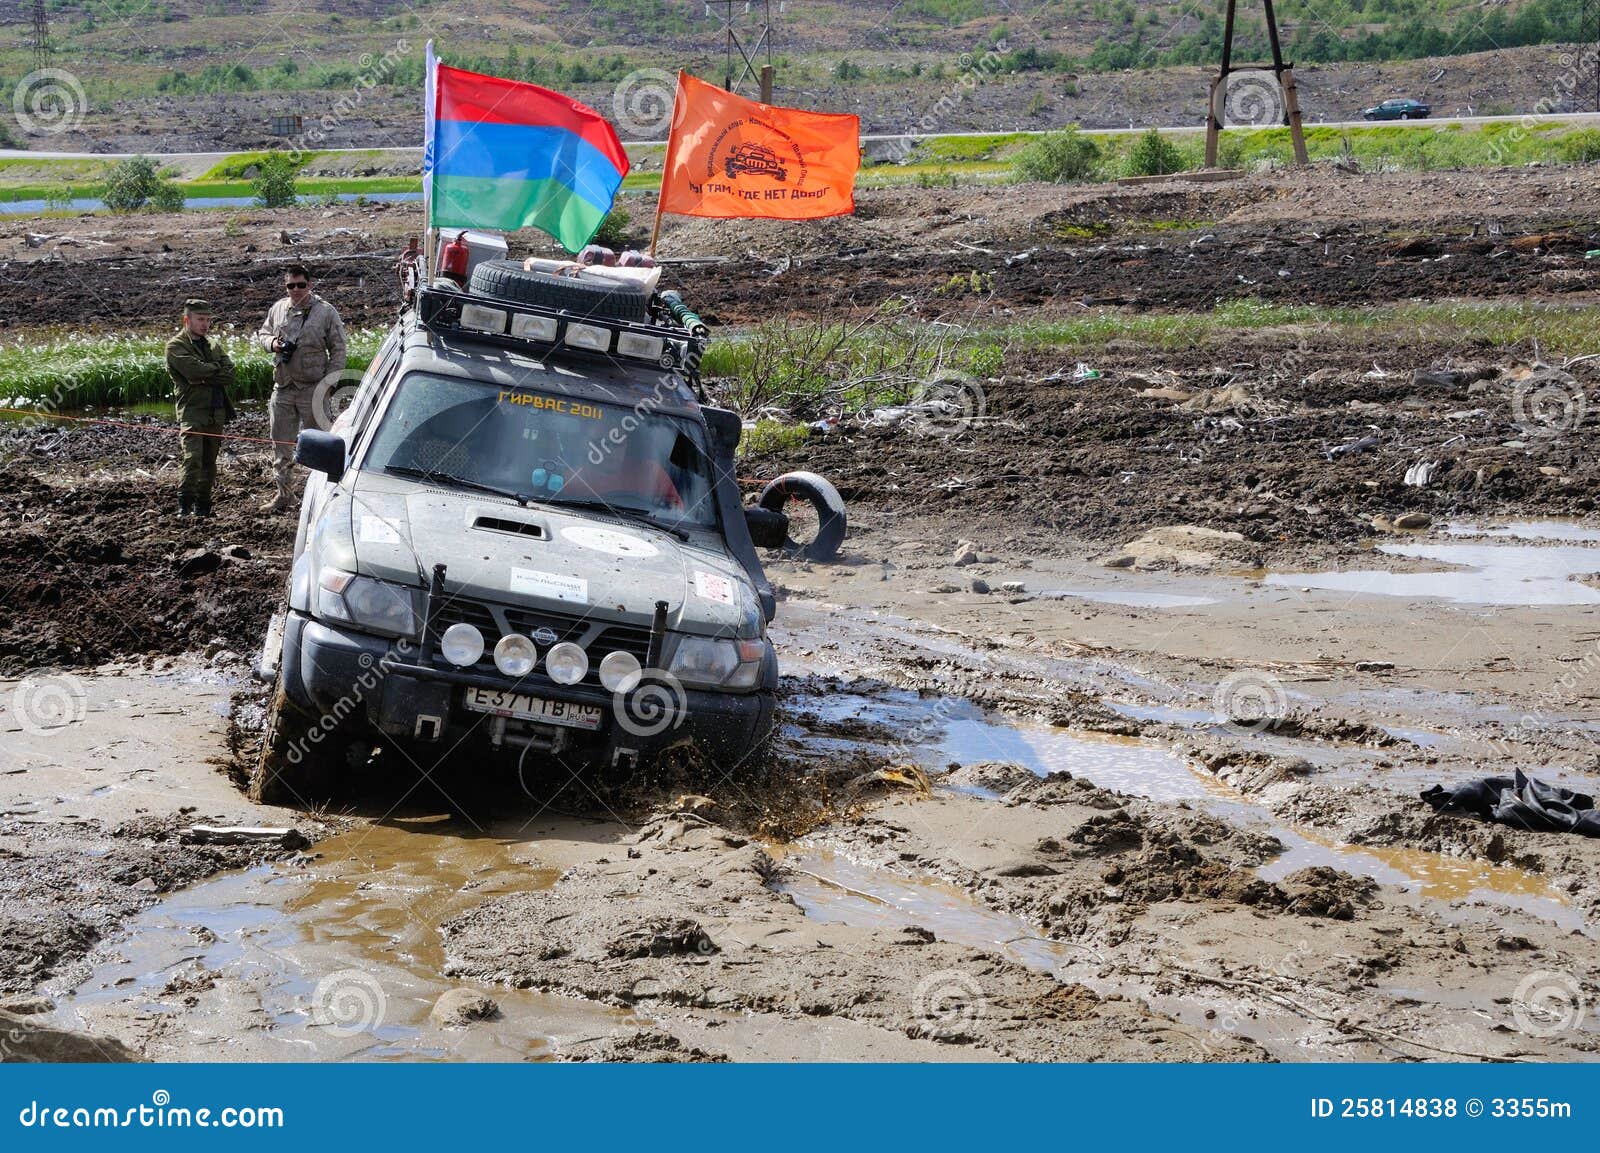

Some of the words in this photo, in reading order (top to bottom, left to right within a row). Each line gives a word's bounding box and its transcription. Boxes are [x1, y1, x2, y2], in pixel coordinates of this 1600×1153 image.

[738, 190, 761, 200] ГДЕ
[764, 189, 788, 200] НЕТ
[498, 391, 567, 413] ГИРВАС
[570, 403, 603, 420] 2011
